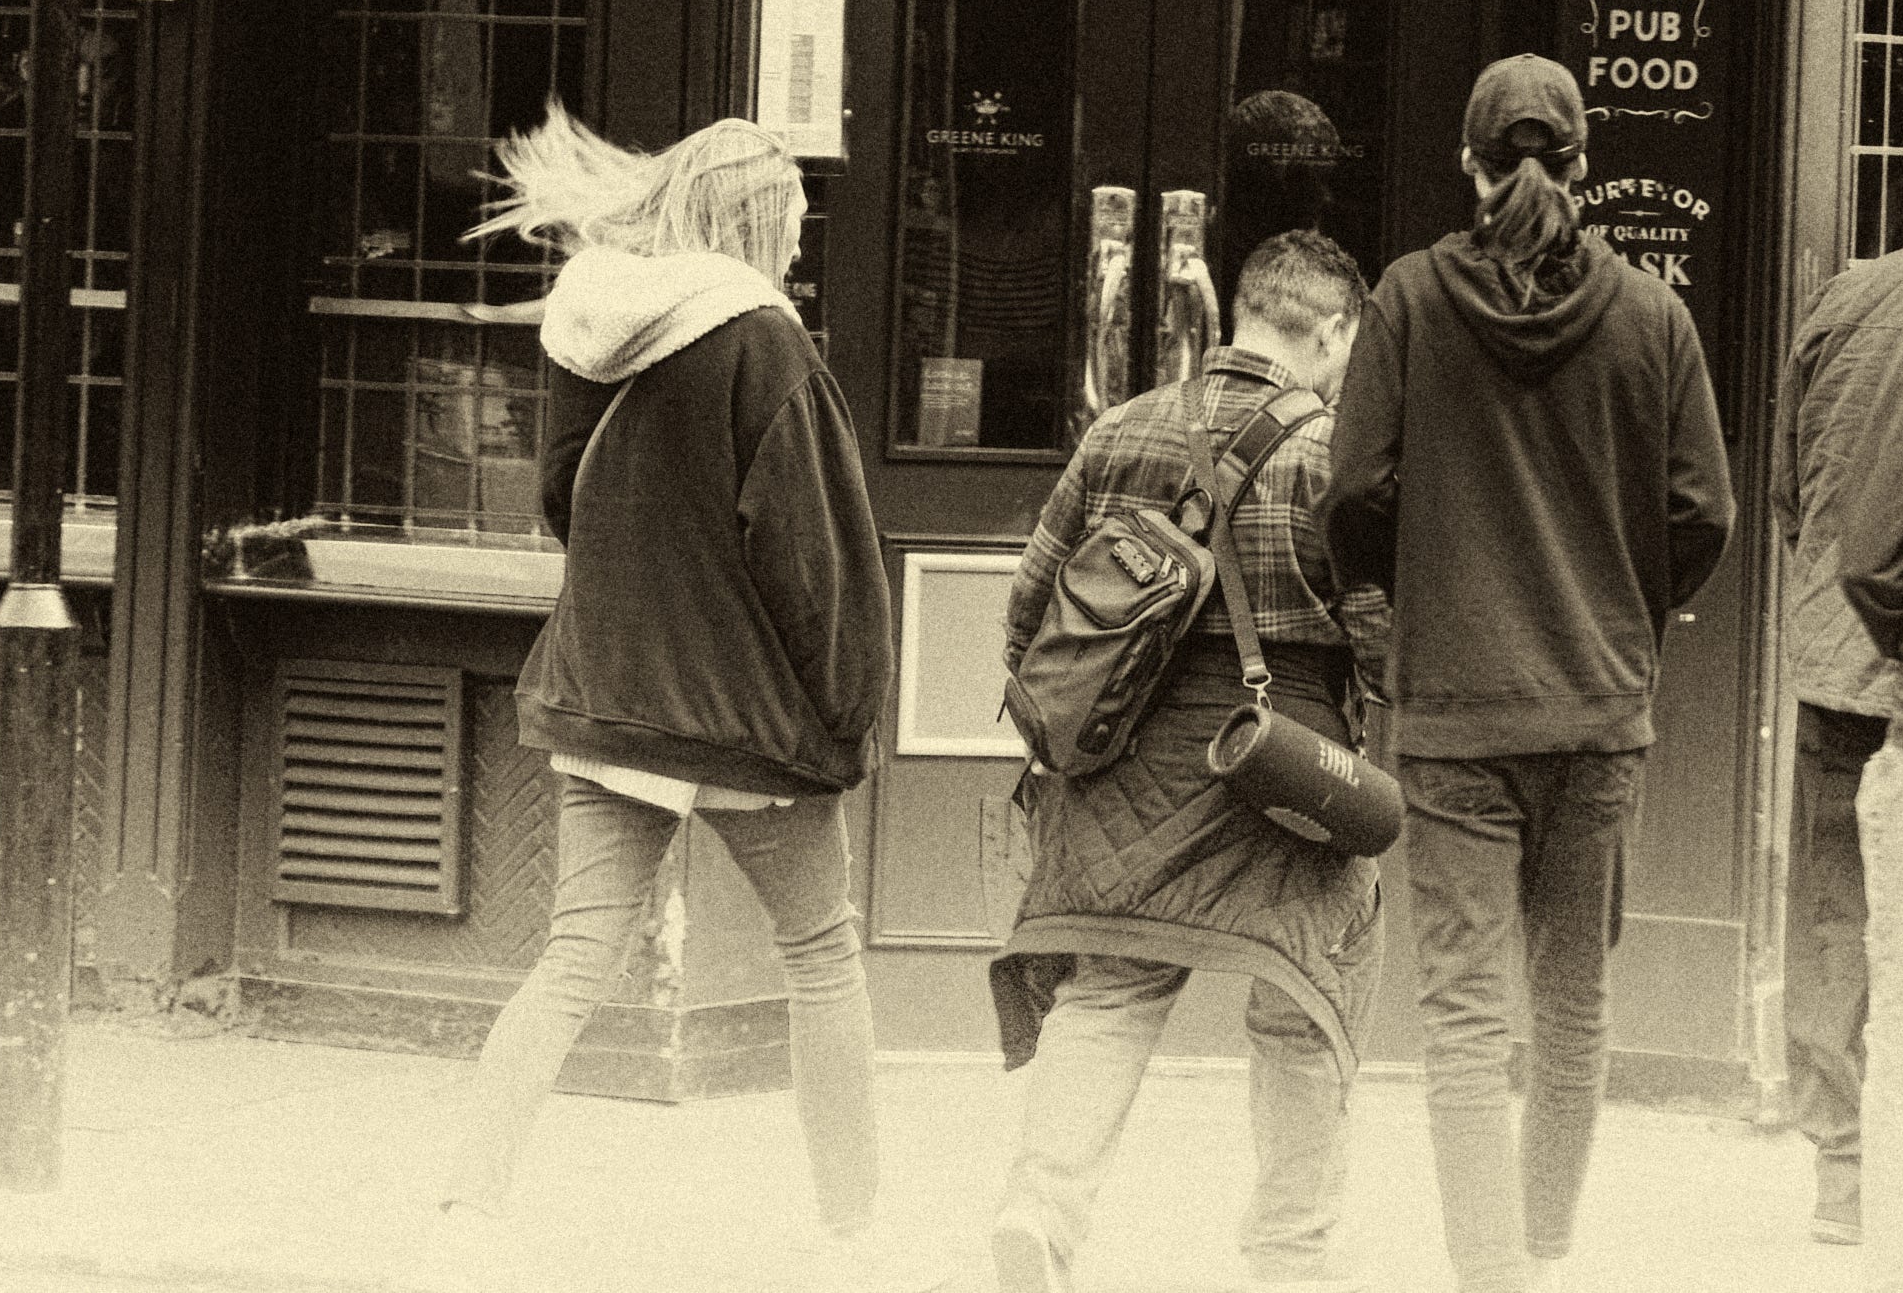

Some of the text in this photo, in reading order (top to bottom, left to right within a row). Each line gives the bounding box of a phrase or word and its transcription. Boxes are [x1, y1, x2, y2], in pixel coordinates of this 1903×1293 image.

[1609, 9, 1681, 42] PUB
[1588, 56, 1699, 90] FOOD
[927, 129, 1044, 147] GREENE KING
[1613, 225, 1690, 242] QUALITY
[1317, 740, 1361, 789] JBL
